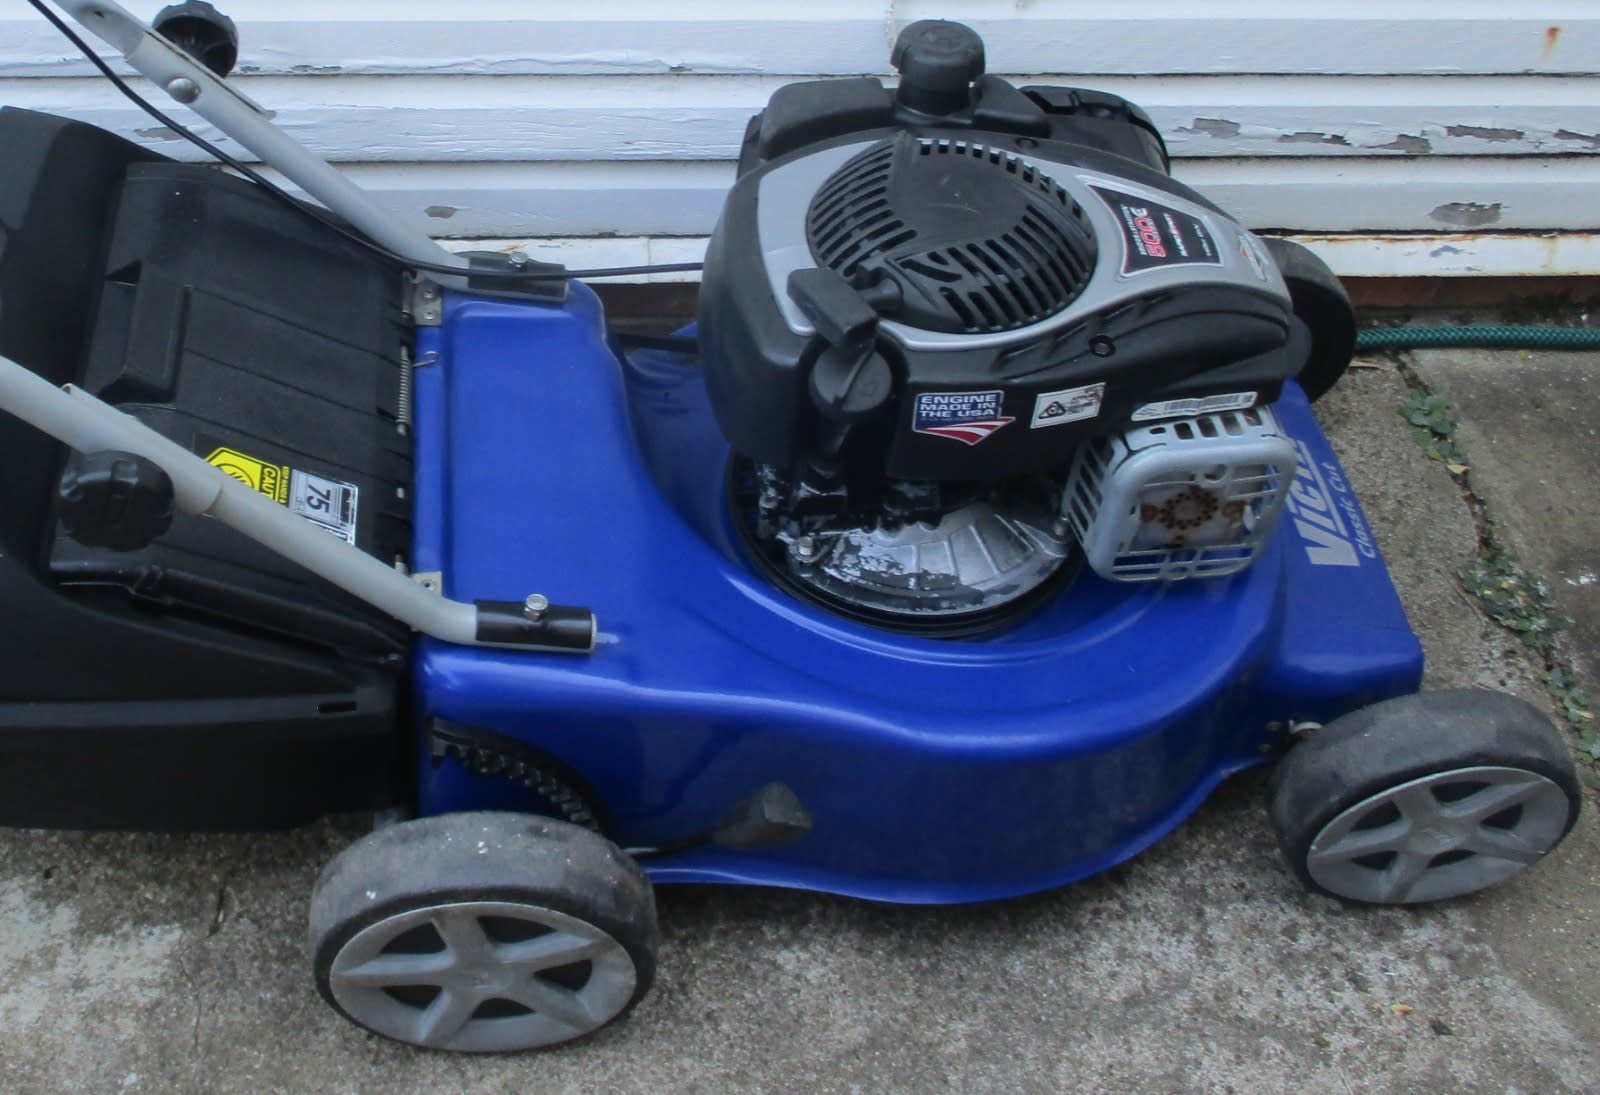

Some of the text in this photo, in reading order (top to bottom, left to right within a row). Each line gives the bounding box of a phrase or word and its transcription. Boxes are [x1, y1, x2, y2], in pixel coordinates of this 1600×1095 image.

[920, 394, 997, 404] ENGINE
[920, 403, 972, 411] MADE
[919, 408, 995, 418] THE USA
[261, 467, 276, 499] CAUT
[306, 484, 331, 513] 75
[1321, 462, 1376, 558] Classic Cut
